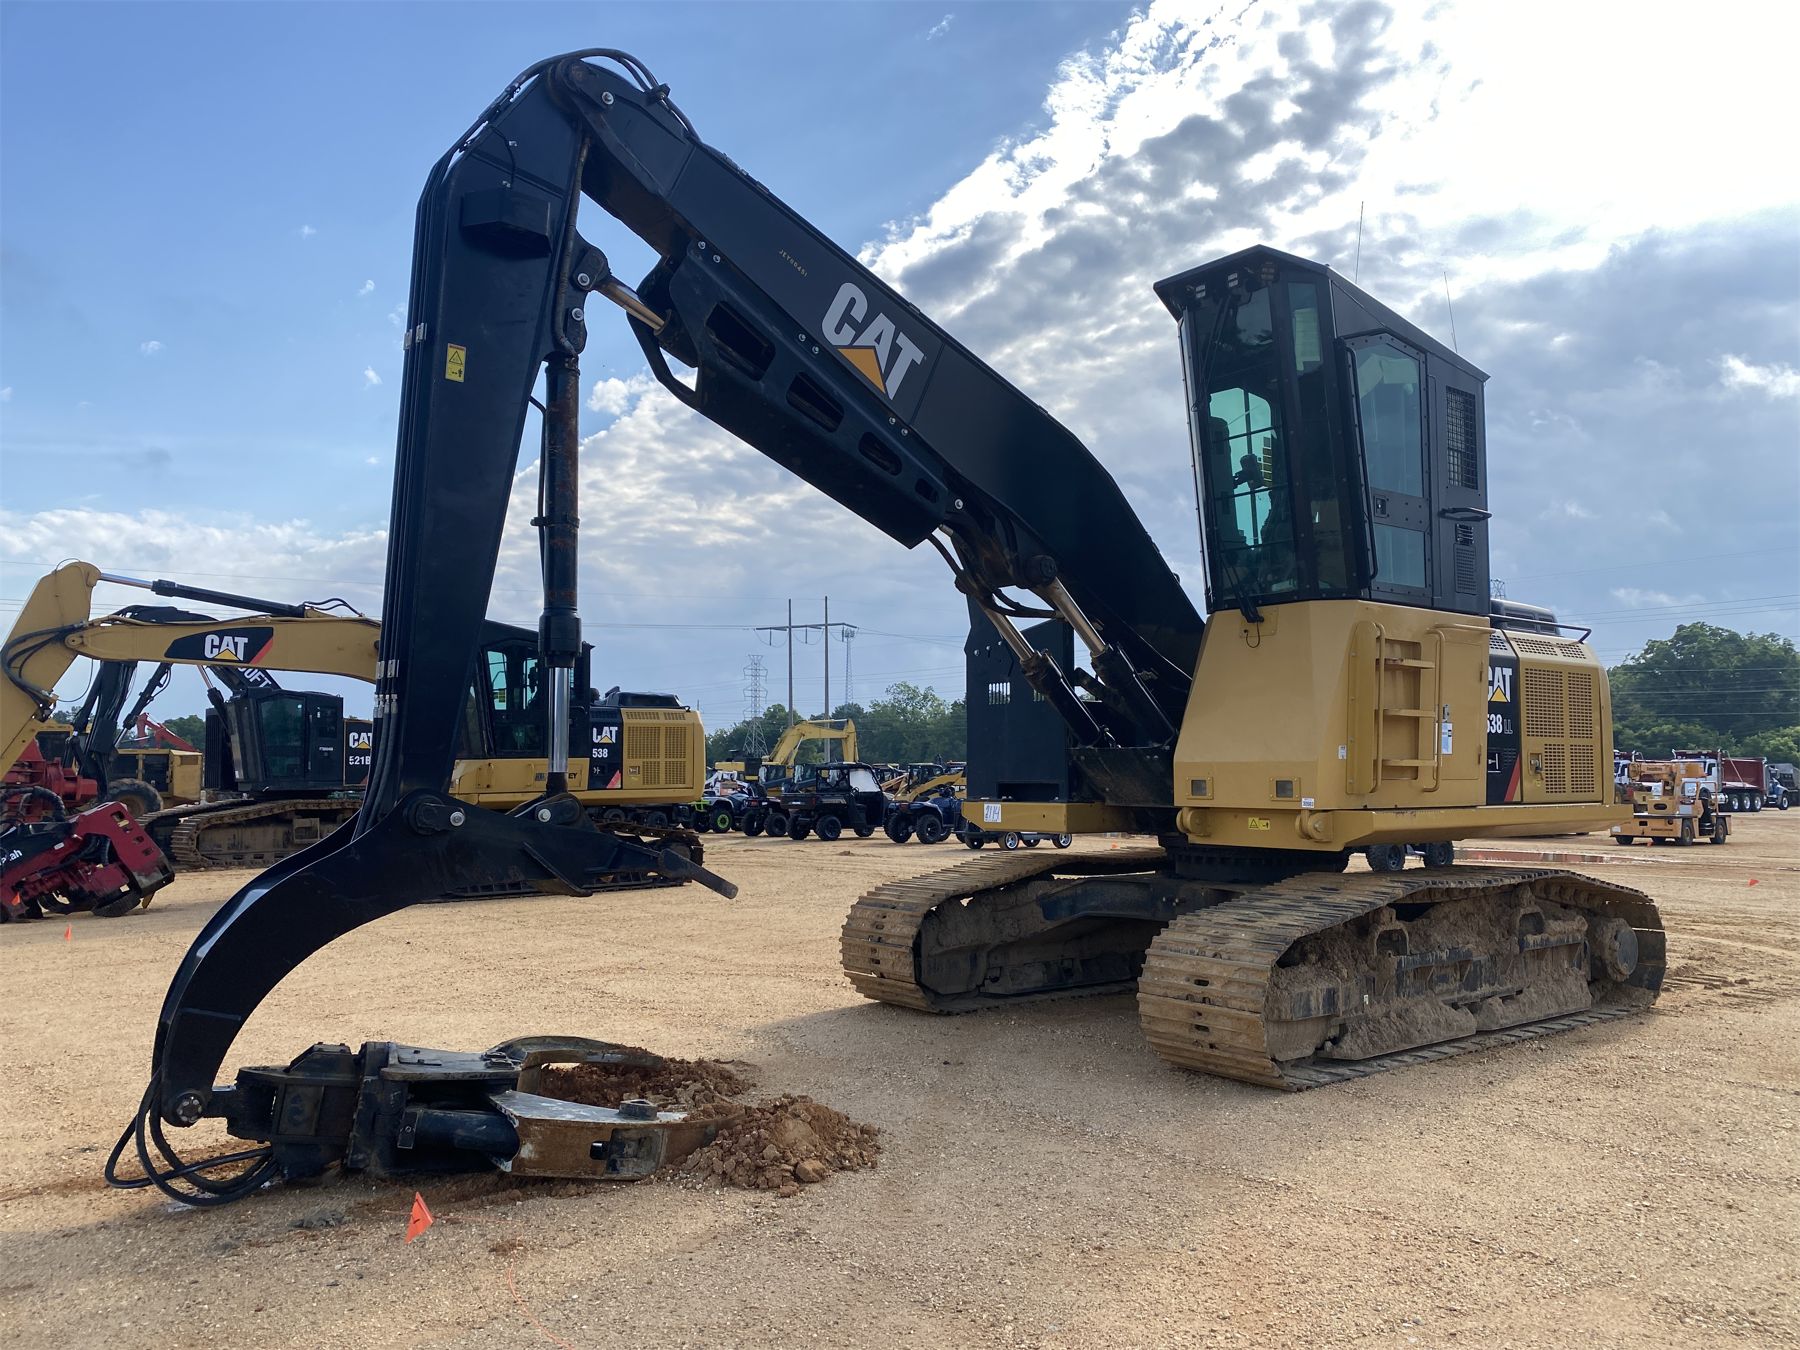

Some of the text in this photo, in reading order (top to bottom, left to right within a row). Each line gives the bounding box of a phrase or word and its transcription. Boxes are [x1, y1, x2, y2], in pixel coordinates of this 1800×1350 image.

[821, 282, 925, 401] CAT
[204, 634, 249, 661] CAT
[592, 726, 618, 744] CAT
[592, 748, 608, 758] 538
